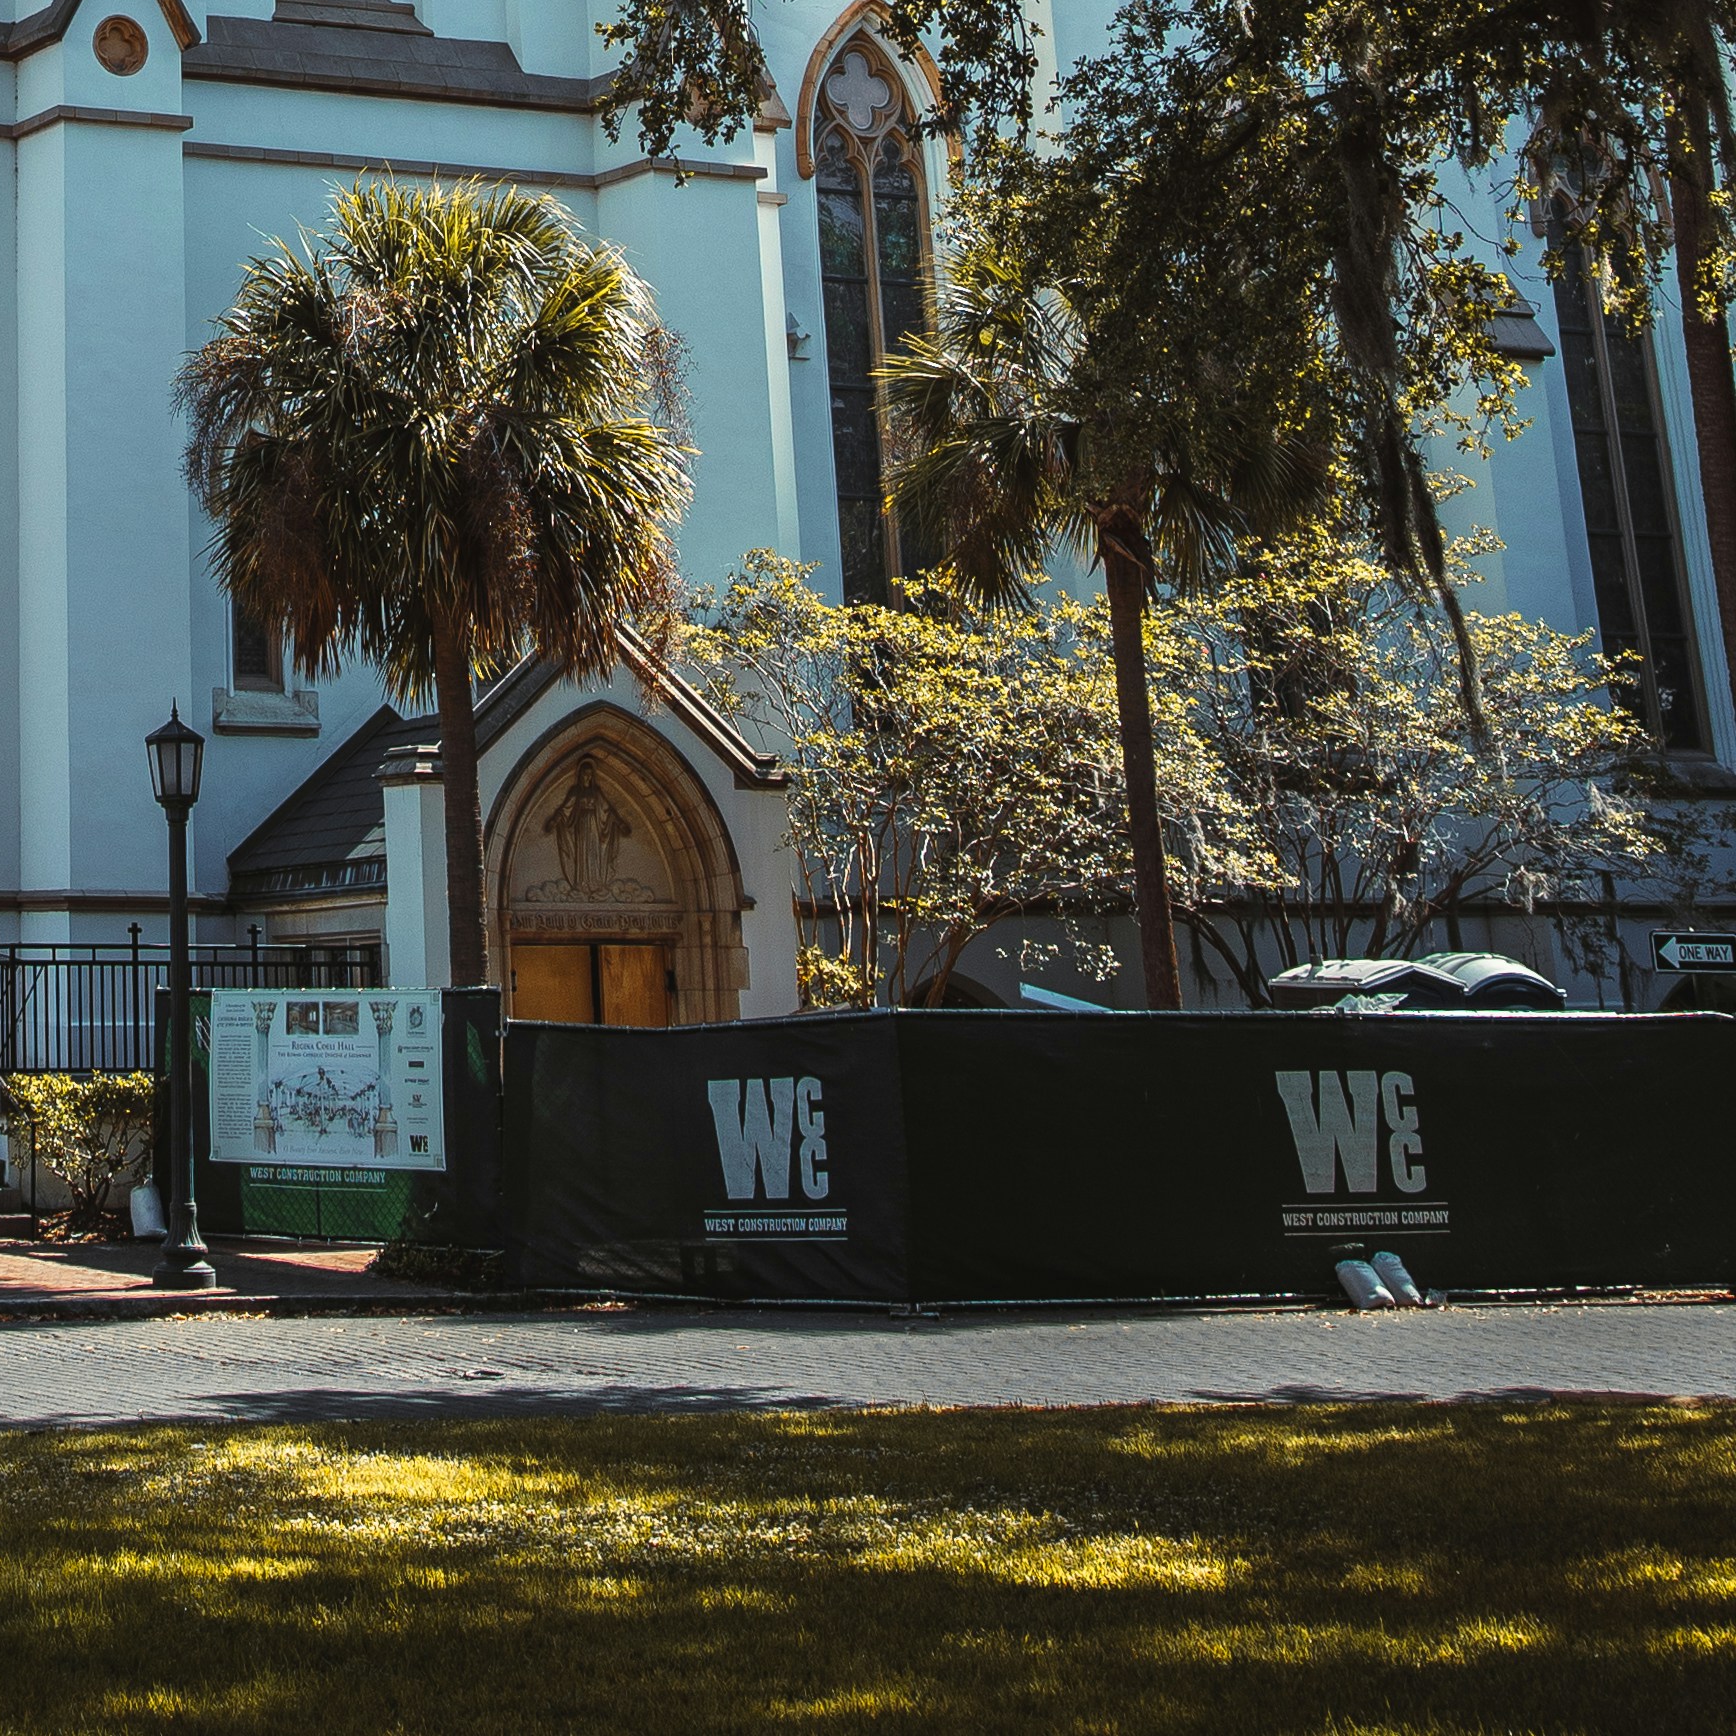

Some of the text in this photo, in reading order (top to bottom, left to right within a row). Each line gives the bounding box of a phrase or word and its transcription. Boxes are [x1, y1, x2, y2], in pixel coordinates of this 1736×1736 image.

[1679, 945, 1729, 960] ONE WAY
[249, 1167, 386, 1184] WEST CONSTRUCTION COMPANY
[704, 1217, 847, 1232] WEST CONSTRUCTION COMPANY
[1282, 1210, 1449, 1226] WEST CONSTRUCTION COMPANY
